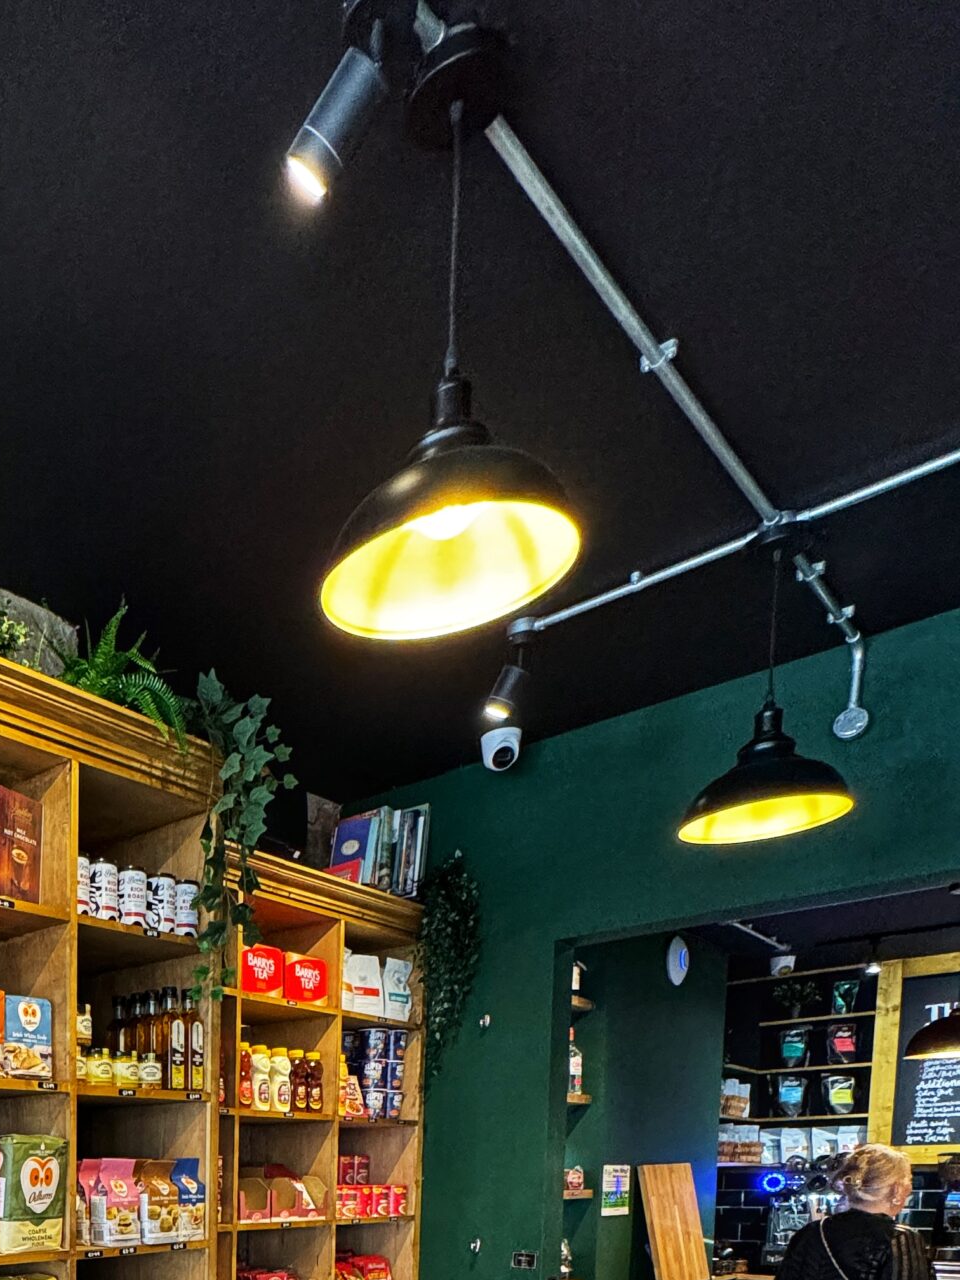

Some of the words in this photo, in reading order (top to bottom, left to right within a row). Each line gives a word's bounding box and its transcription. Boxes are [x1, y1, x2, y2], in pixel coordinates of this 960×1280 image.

[253, 967, 269, 981] TEA
[301, 978, 315, 990] TEA
[28, 1191, 53, 1203] Odlums
[21, 1234, 53, 1242] WHOLEMEAL
